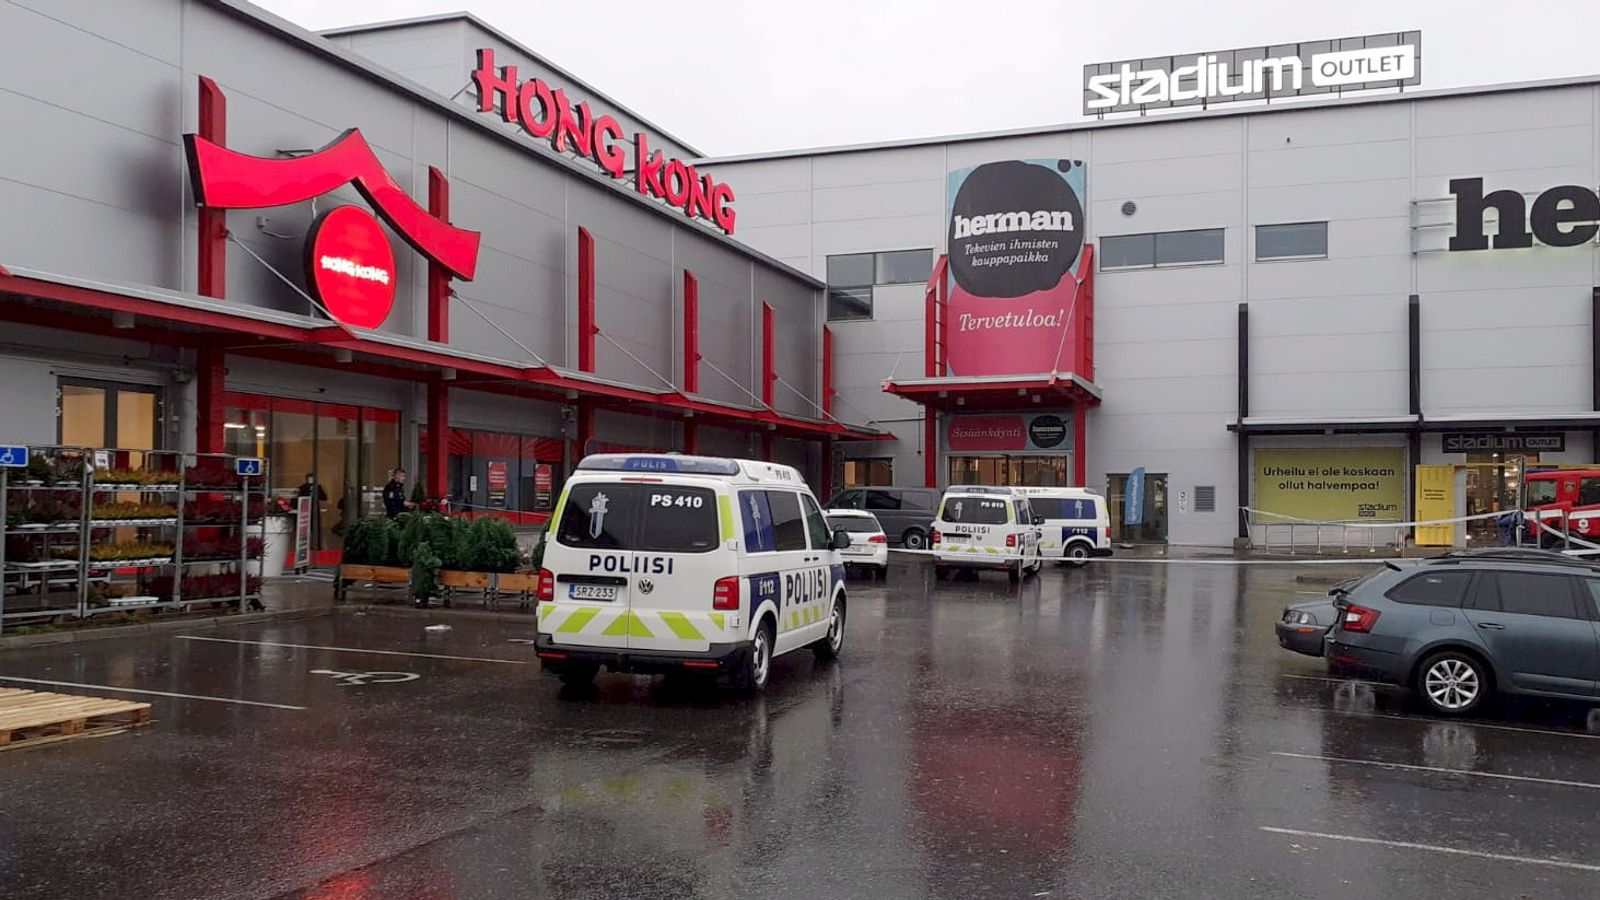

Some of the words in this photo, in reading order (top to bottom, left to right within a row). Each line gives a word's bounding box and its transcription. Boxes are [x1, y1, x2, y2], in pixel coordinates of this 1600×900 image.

[1087, 55, 1302, 109] stadium
[1320, 54, 1405, 78] OUTLET
[470, 48, 625, 179] HONG
[634, 132, 736, 235] KONG
[954, 210, 1074, 240] herman
[964, 241, 1006, 255] Tekevien
[1009, 239, 1059, 251] ihmisten
[972, 253, 1050, 267] kauppapaikka
[321, 255, 355, 277] HONG
[356, 264, 389, 285] KONG
[959, 309, 1064, 332] Tervetuloa!
[1447, 434, 1521, 449] stadium
[1263, 467, 1305, 476] Urheilu
[1308, 467, 1319, 476] ei
[1322, 467, 1340, 476] ole
[1343, 467, 1395, 476] koskaan
[1279, 481, 1304, 490] ollut
[1307, 481, 1380, 492] halvempaa!
[651, 494, 672, 507] PS
[675, 495, 703, 508] 410
[1358, 503, 1397, 511] stadium
[956, 525, 990, 534] POLIISI
[589, 554, 673, 575] POLIISI
[576, 586, 614, 598] SRZ-233
[786, 569, 827, 607] POLIISI
